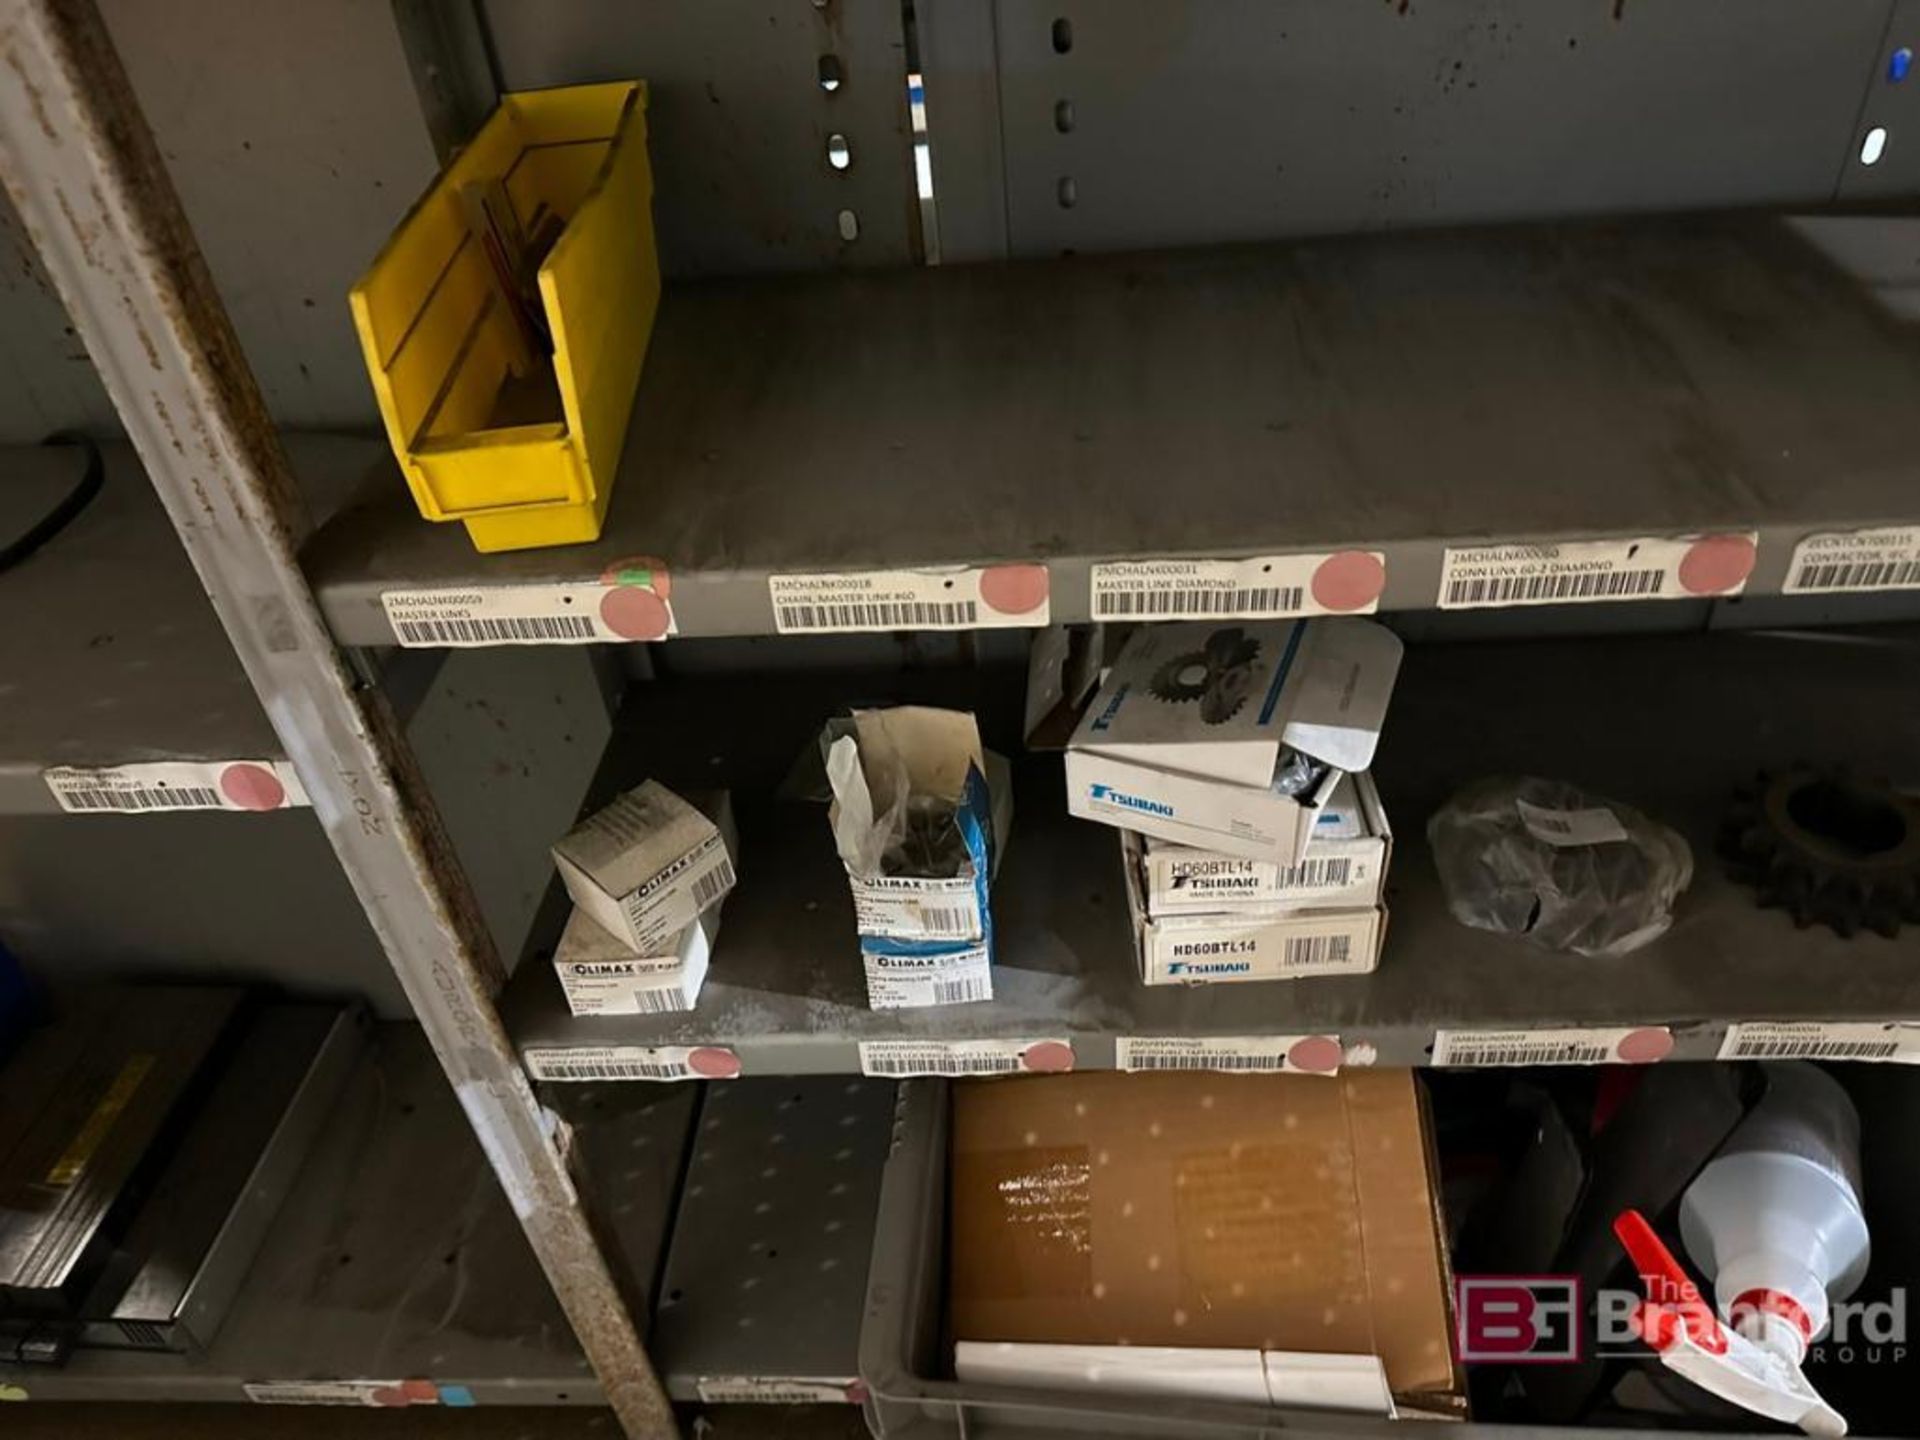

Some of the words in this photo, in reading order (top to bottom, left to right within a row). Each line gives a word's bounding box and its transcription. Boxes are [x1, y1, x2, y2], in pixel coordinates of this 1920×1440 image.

[1450, 568, 1487, 579] CONN
[1490, 566, 1517, 577] LINK
[1550, 560, 1614, 573] DIAMOND
[1096, 580, 1144, 590] MASTER
[1147, 579, 1172, 590] LINK
[1175, 578, 1237, 590] DIAMOND
[818, 592, 864, 603] MASTER
[866, 592, 891, 602] LINK
[392, 608, 438, 621] MASTER
[439, 607, 472, 619] LINKS
[1108, 790, 1174, 818] TSUBAKI
[637, 857, 688, 898] CLIMAX
[1190, 876, 1260, 890] TSUBAKI
[1173, 939, 1257, 957] HD60BTL14
[574, 962, 635, 976] CLIMAX
[877, 956, 937, 968] CLIMAX
[1186, 961, 1251, 975] TSUBAKI
